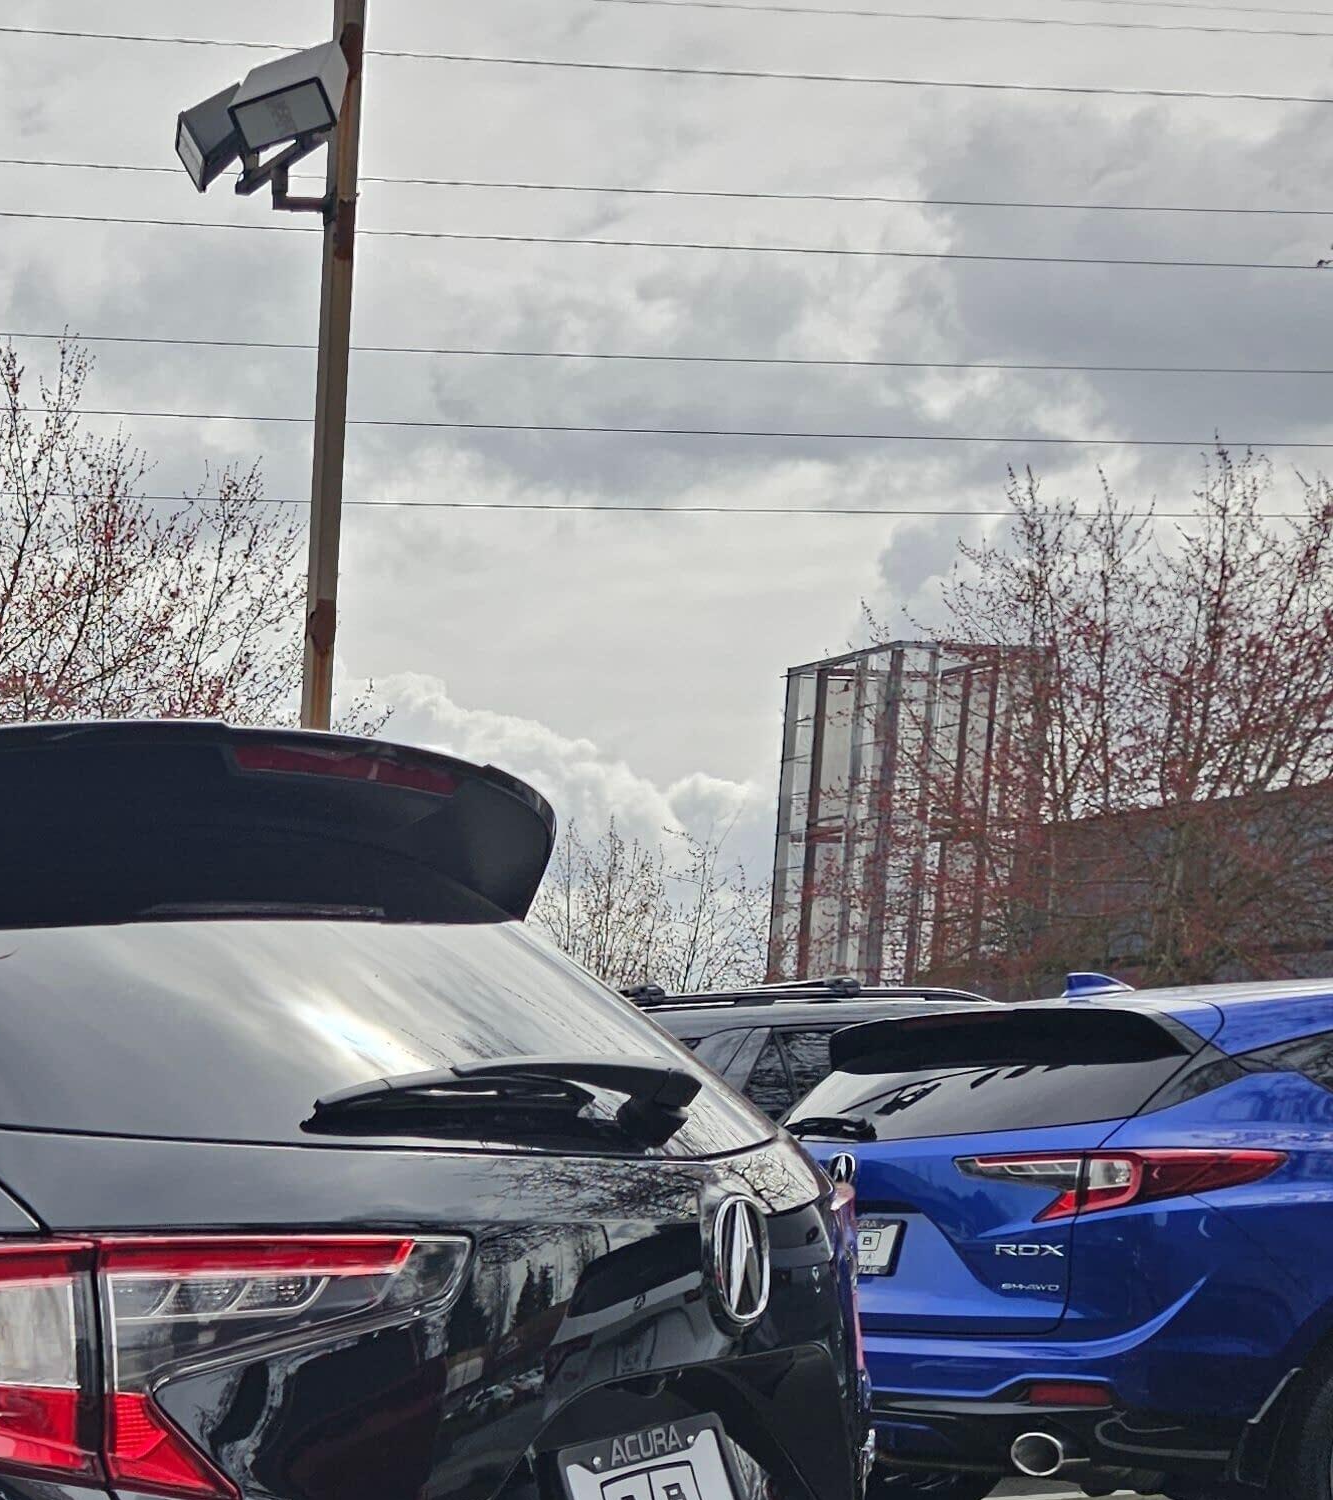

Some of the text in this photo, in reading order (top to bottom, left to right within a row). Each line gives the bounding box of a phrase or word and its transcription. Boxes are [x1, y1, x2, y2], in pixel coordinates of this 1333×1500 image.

[994, 1244, 1065, 1257] RDX
[1000, 1282, 1061, 1292] SH-AWD
[610, 1424, 682, 1467] ACURA
